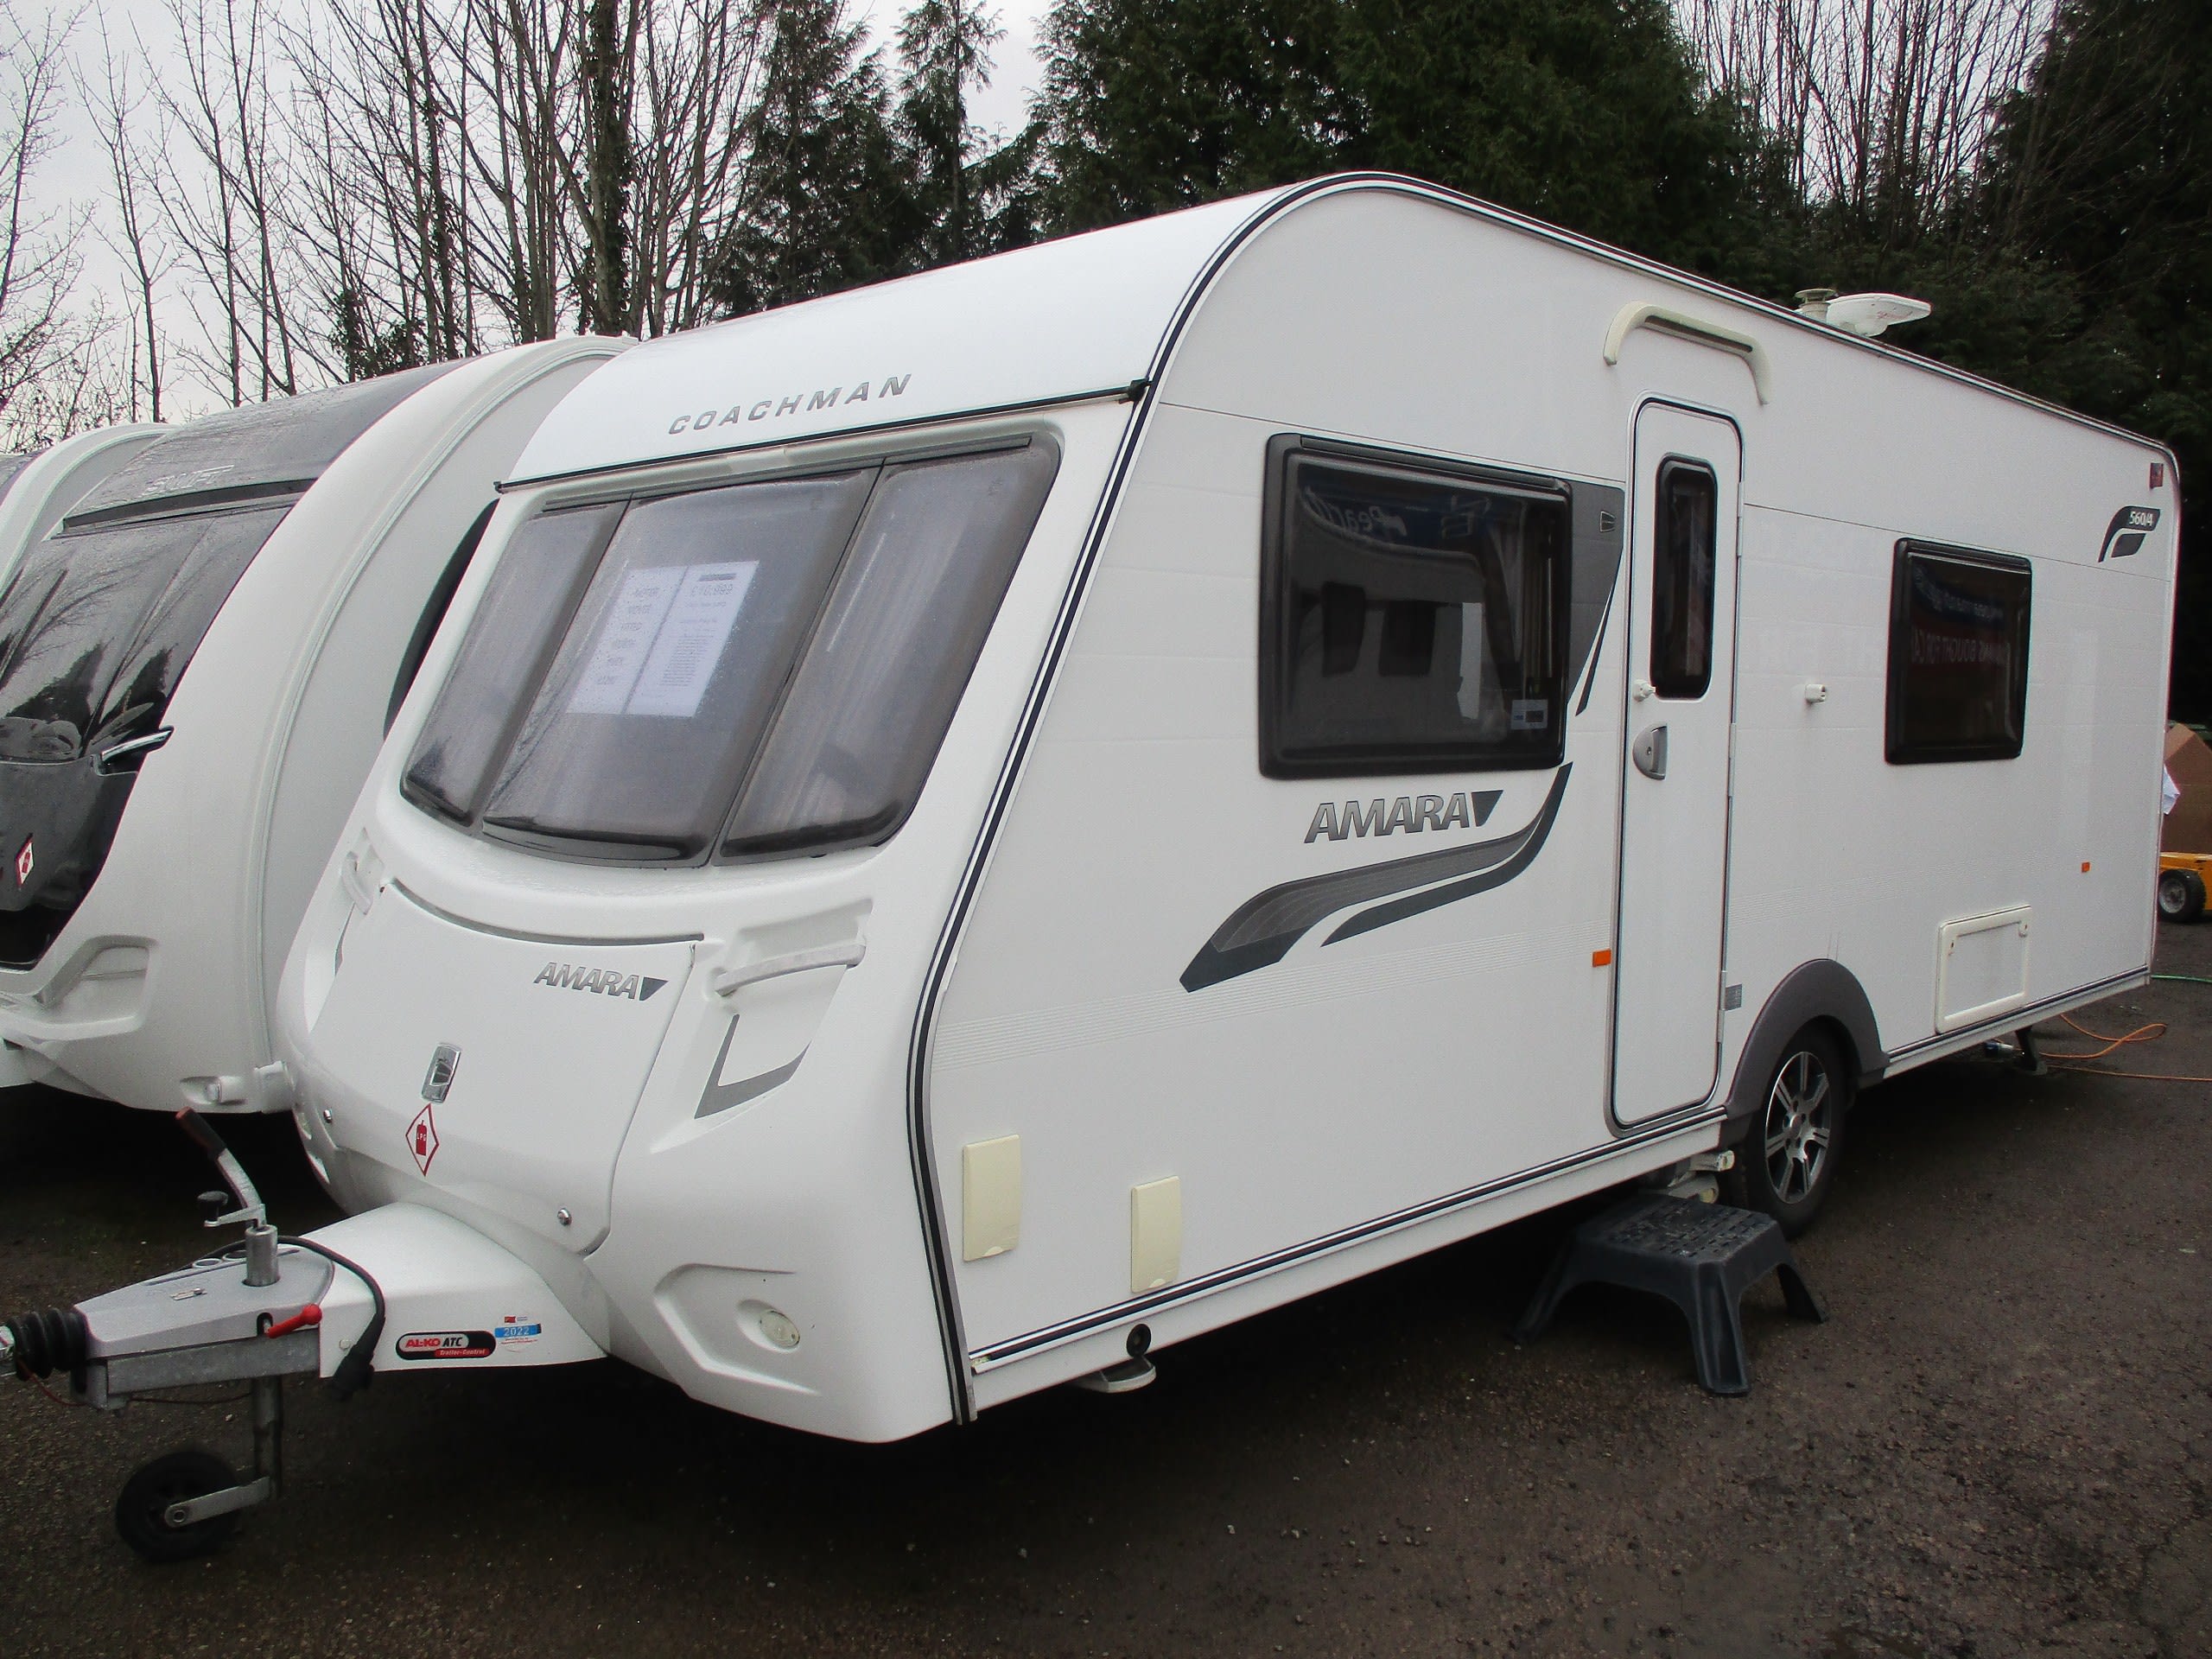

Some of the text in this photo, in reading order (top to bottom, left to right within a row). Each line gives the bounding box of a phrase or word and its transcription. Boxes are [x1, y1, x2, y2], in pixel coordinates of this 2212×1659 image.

[668, 373, 912, 435] COACHMAN
[141, 465, 234, 495] SWIFT
[1304, 792, 1470, 843] AMARA
[532, 961, 639, 1000] AMARA
[442, 1337, 463, 1347] ATC
[504, 1326, 530, 1337] 2022
